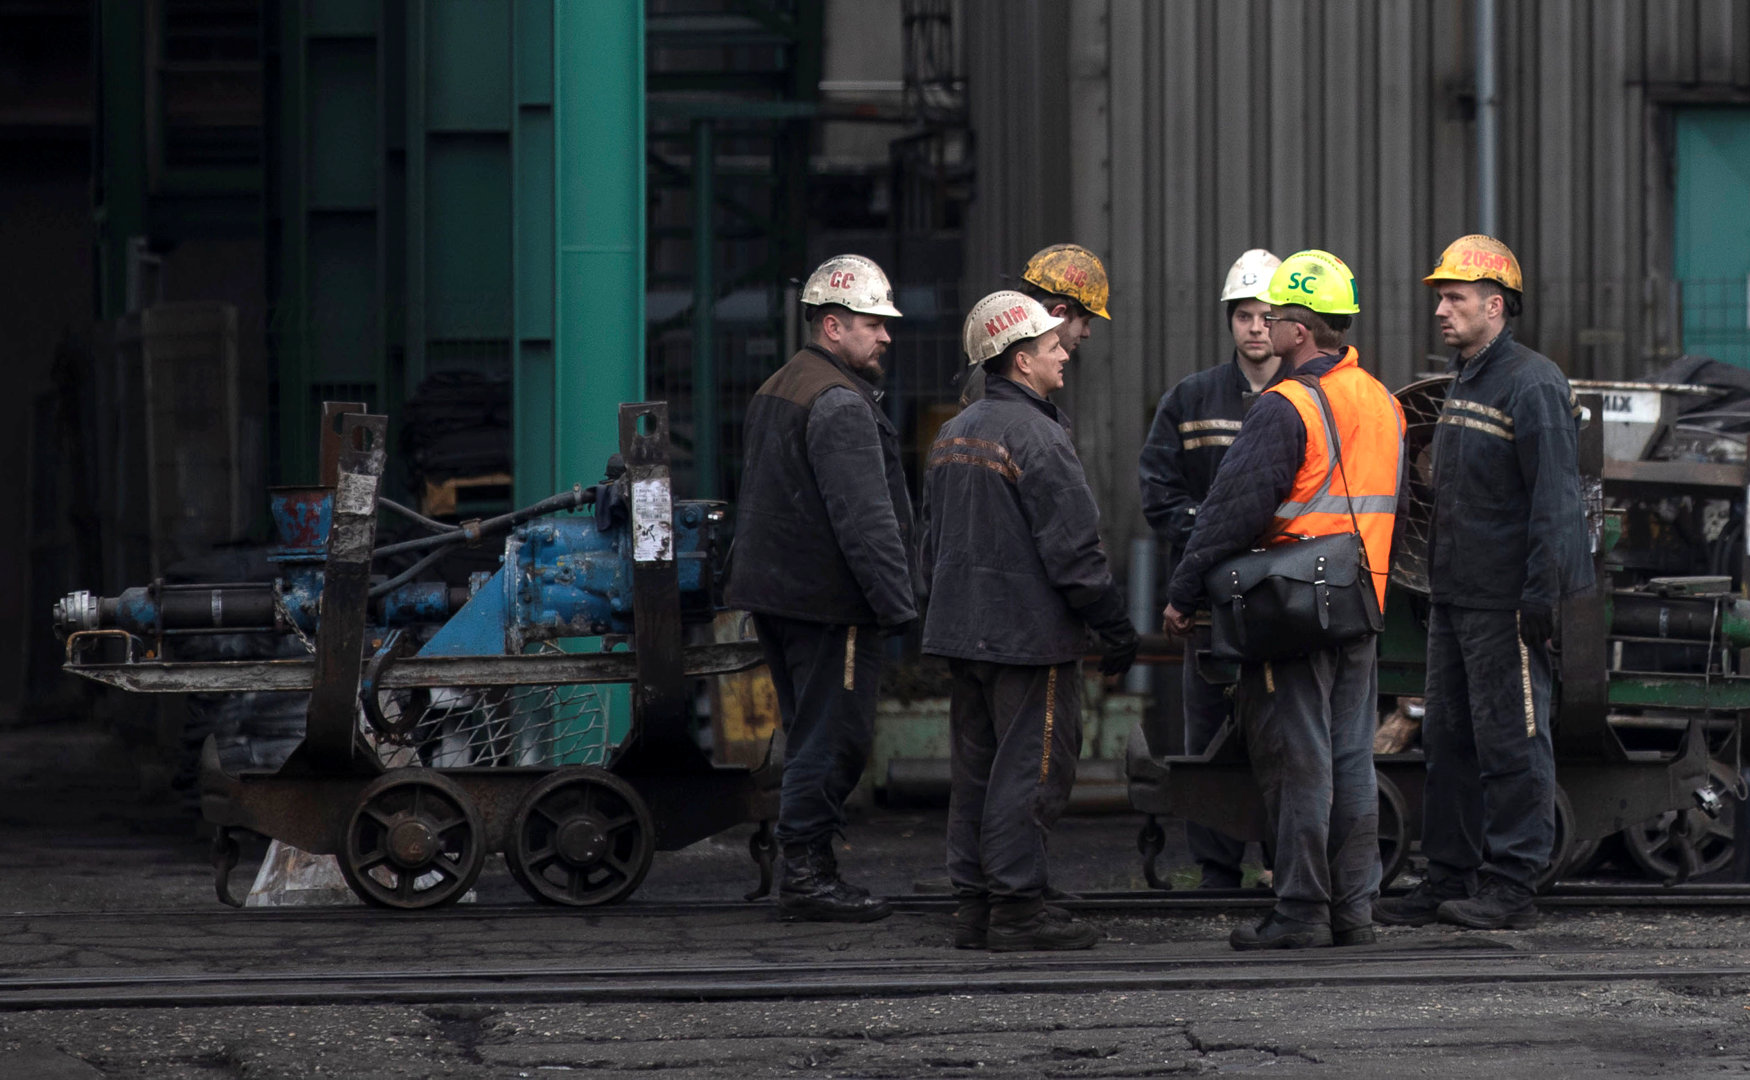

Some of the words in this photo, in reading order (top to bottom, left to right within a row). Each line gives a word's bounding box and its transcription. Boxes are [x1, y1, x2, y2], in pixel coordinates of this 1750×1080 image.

[1462, 250, 1511, 272] 20597
[1288, 272, 1317, 294] SC
[985, 305, 1028, 337] KLIM
